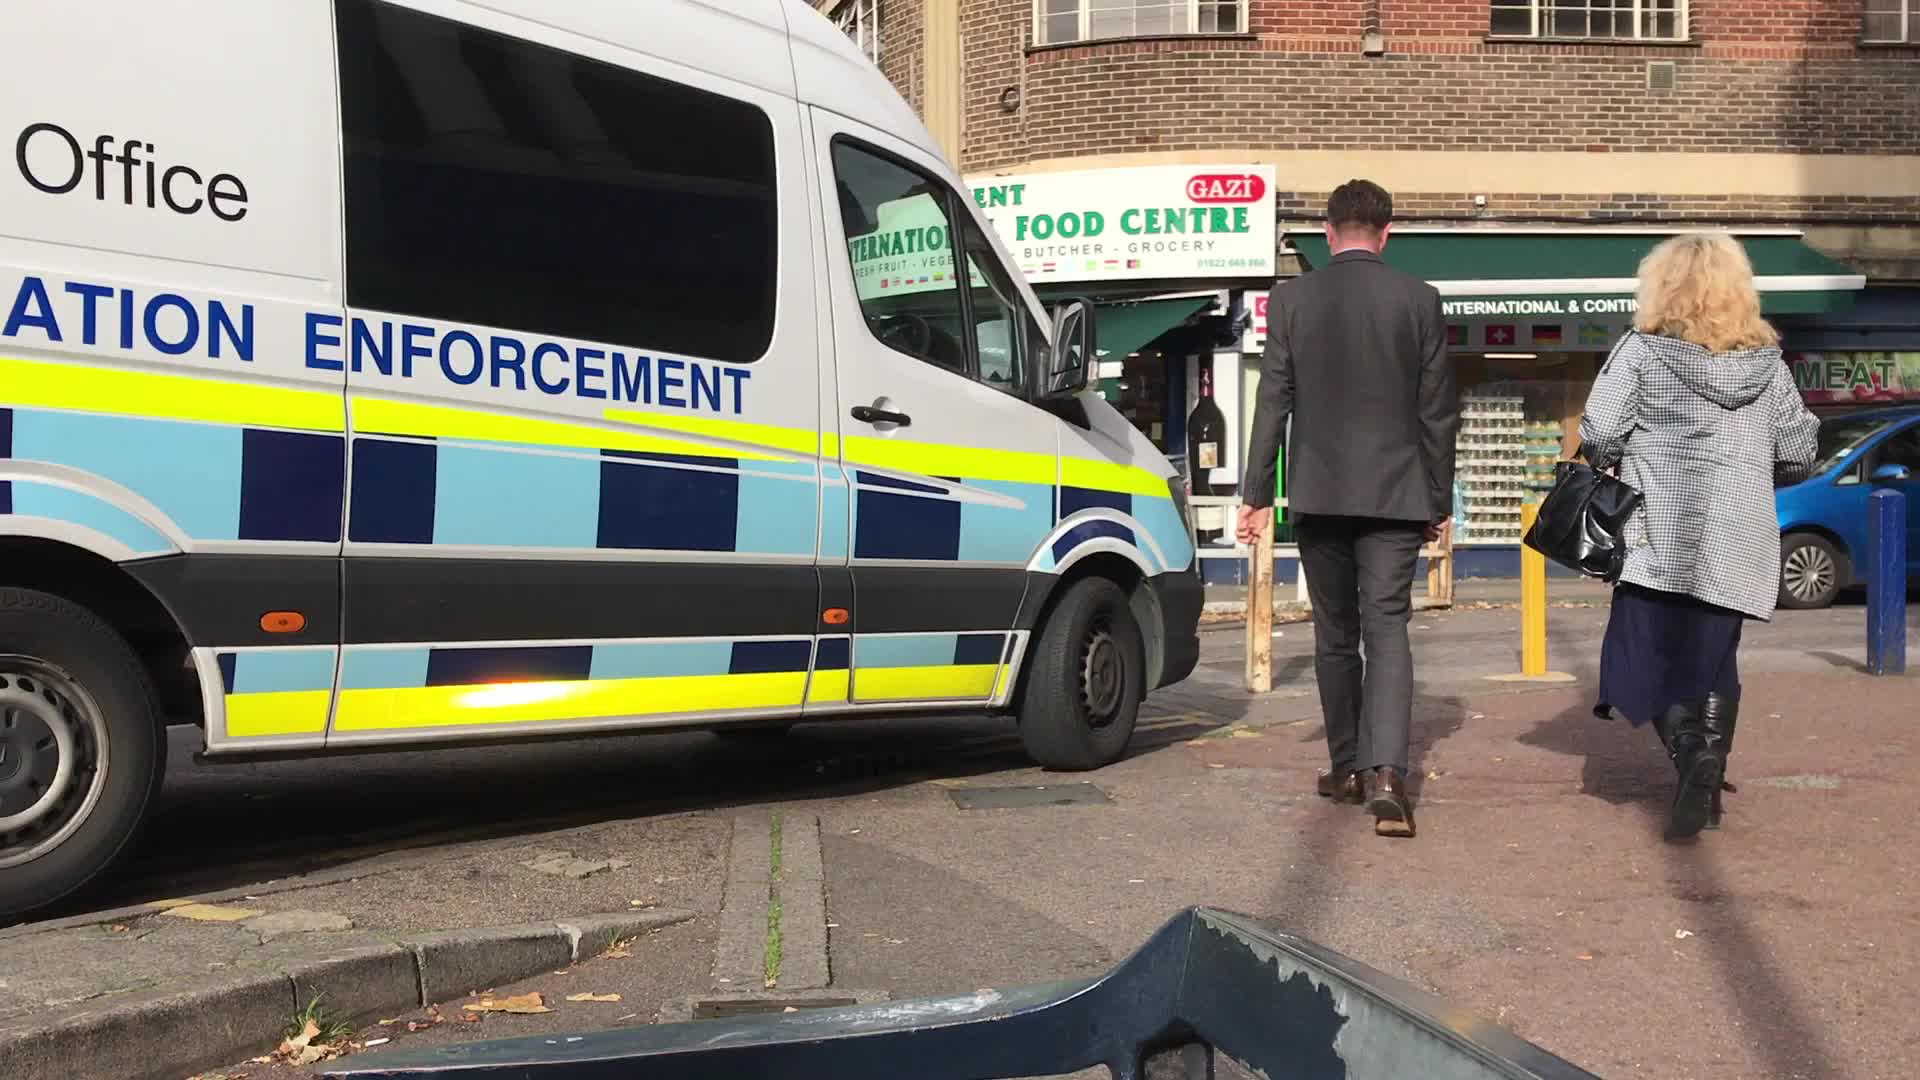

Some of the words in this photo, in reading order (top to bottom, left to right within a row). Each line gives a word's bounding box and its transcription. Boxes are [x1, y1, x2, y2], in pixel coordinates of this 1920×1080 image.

[16, 122, 249, 222] Office
[968, 184, 1026, 209] ENT
[848, 225, 953, 263] TERNATIO
[1016, 211, 1106, 241] FOOD
[1119, 206, 1249, 236] CENTRE
[879, 259, 907, 273] FRUIT
[1024, 243, 1104, 258] BUTCHER
[1127, 240, 1216, 254] GROCERY
[1442, 300, 1565, 315] NTERNATIONAL
[1568, 300, 1580, 313] &
[3, 276, 254, 362] ATION
[305, 312, 751, 414] ENFORCEMENT
[1794, 360, 1896, 391] MEAT
